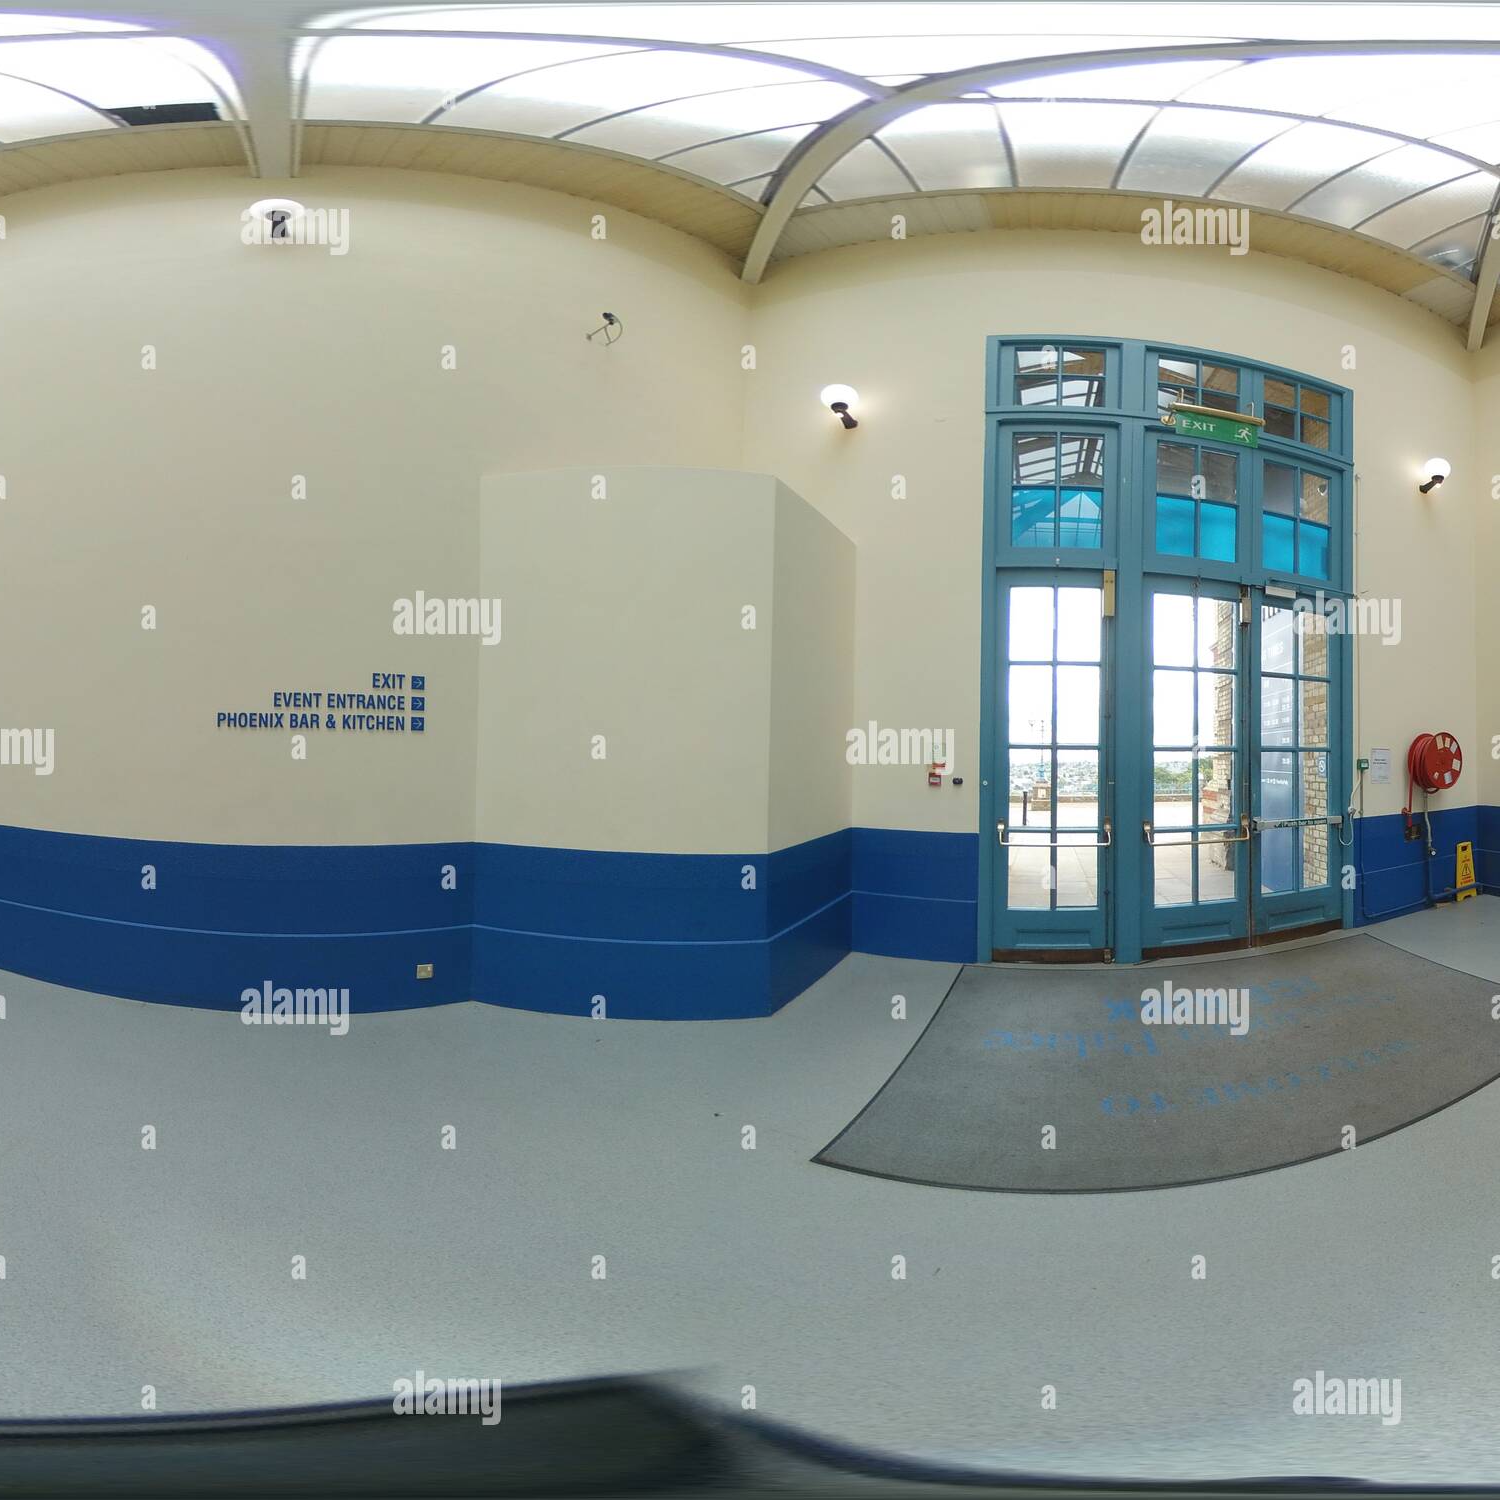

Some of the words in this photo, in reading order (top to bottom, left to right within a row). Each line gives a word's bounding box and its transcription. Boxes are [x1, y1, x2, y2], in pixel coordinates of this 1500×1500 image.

[1182, 419, 1216, 432] EXIT
[372, 672, 406, 690] EXIT
[273, 692, 322, 708] EVENT
[327, 693, 406, 711] ENTRANCE
[216, 712, 284, 729] PHOENIX
[290, 713, 320, 730] BAR
[325, 714, 336, 729] &
[342, 714, 406, 732] KITCHEN
